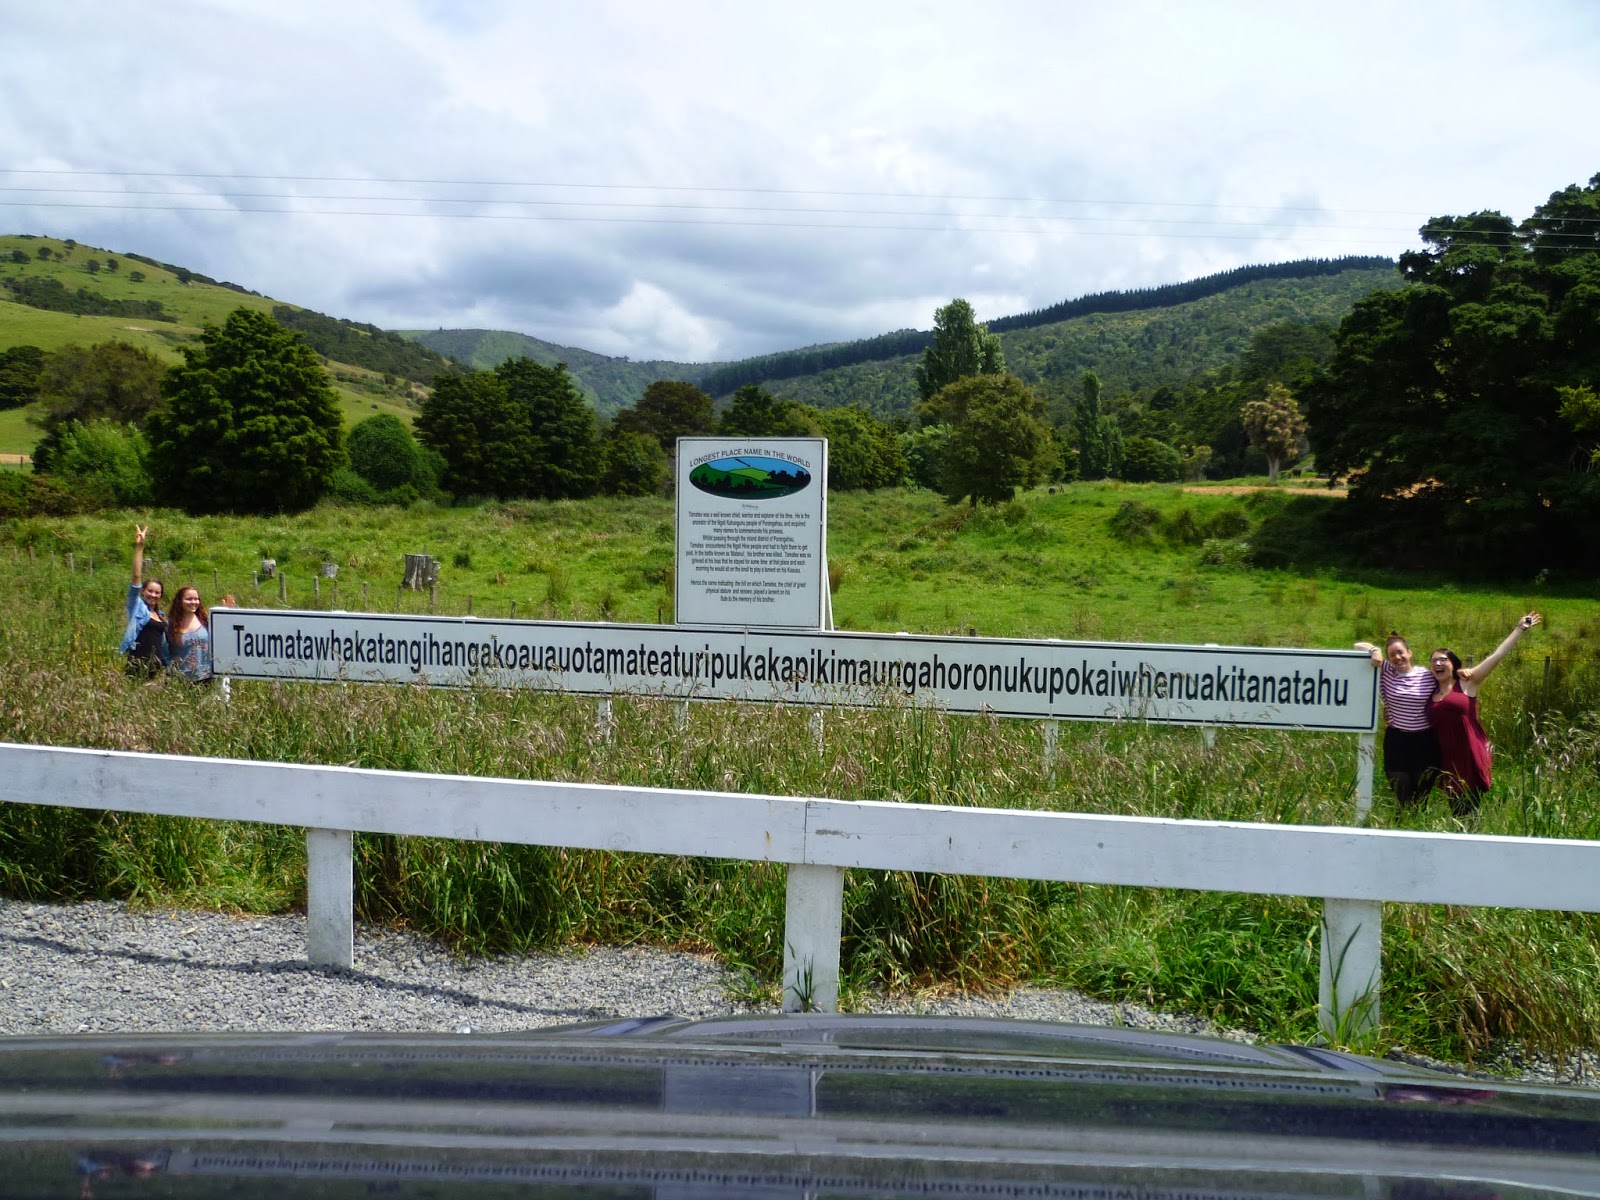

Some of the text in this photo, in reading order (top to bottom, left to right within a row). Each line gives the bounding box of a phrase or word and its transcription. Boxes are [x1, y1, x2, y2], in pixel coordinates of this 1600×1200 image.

[690, 452, 720, 467] LONGEST
[722, 449, 742, 458] PLACE
[772, 451, 785, 459] THE
[787, 454, 811, 468] WORLD
[233, 624, 1349, 707] Taumatawhakatangihangakoauauotamateaturipukakapikimaungahoronukupokaiwhenuakitanatahu
